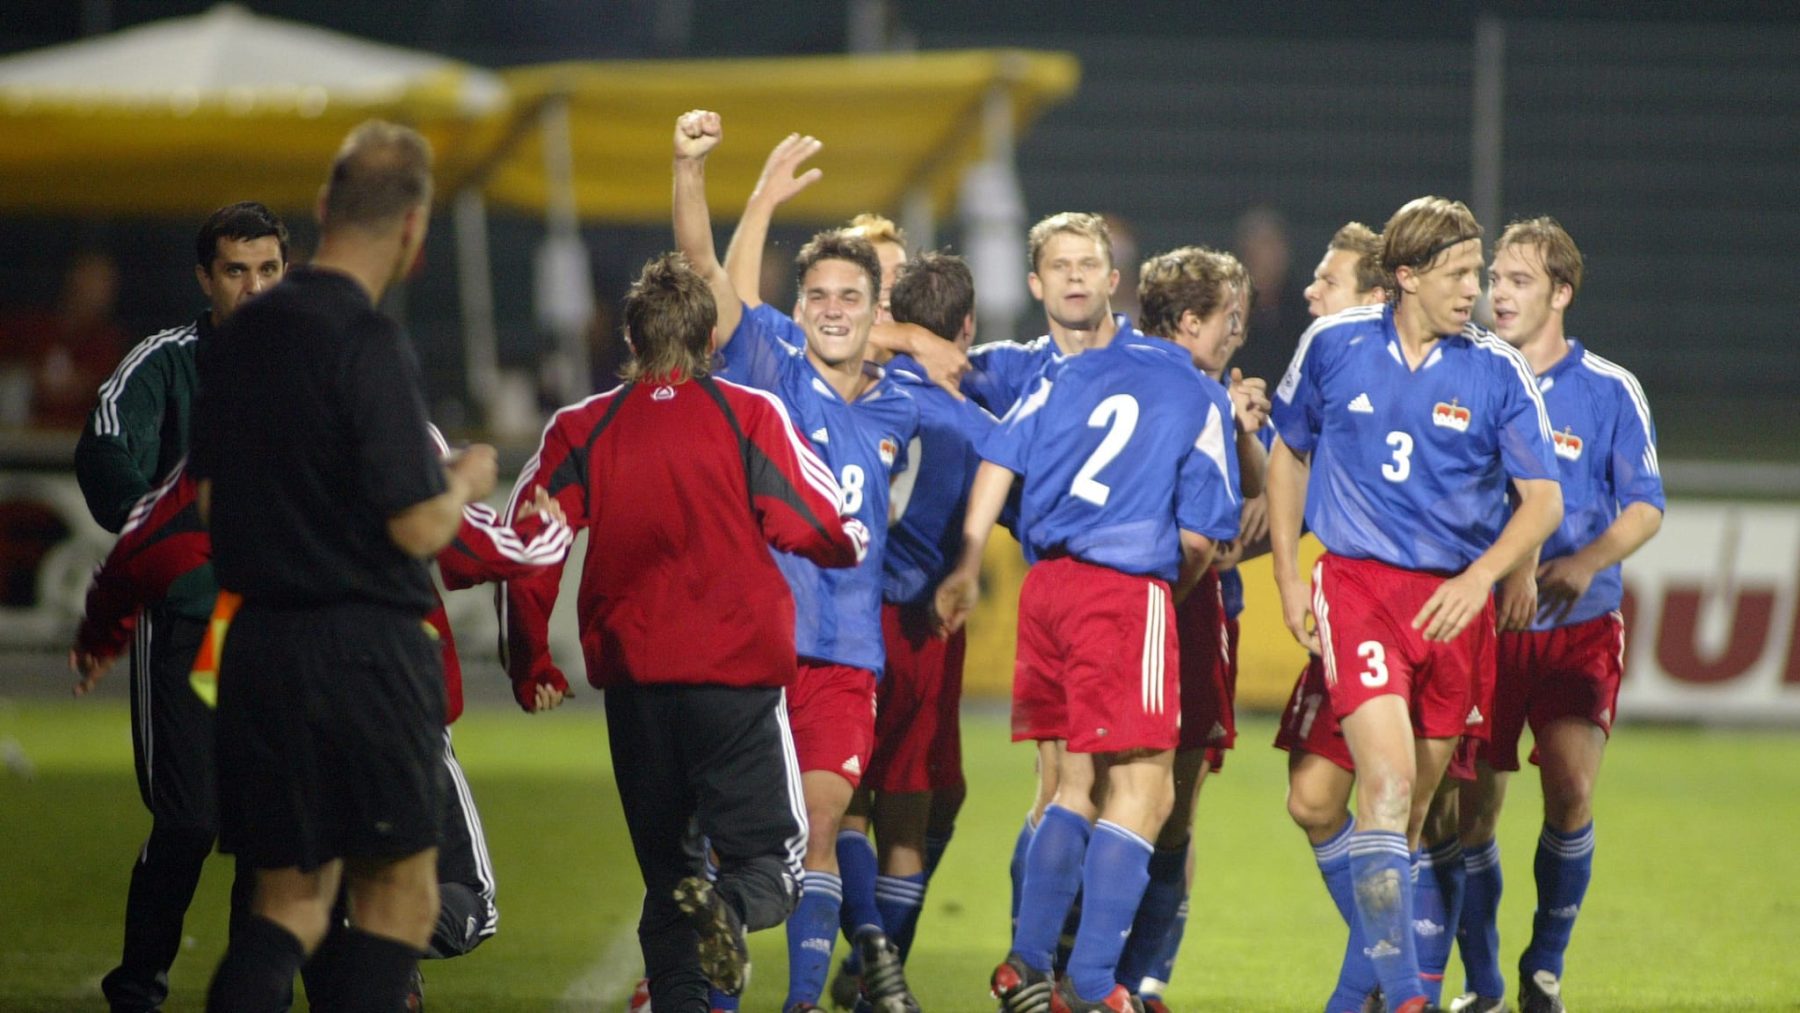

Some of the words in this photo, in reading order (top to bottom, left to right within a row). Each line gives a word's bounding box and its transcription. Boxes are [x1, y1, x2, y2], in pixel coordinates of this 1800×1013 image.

[1069, 393, 1139, 506] 2
[1382, 431, 1413, 482] 3
[841, 464, 864, 514] 8
[1357, 640, 1388, 687] 3
